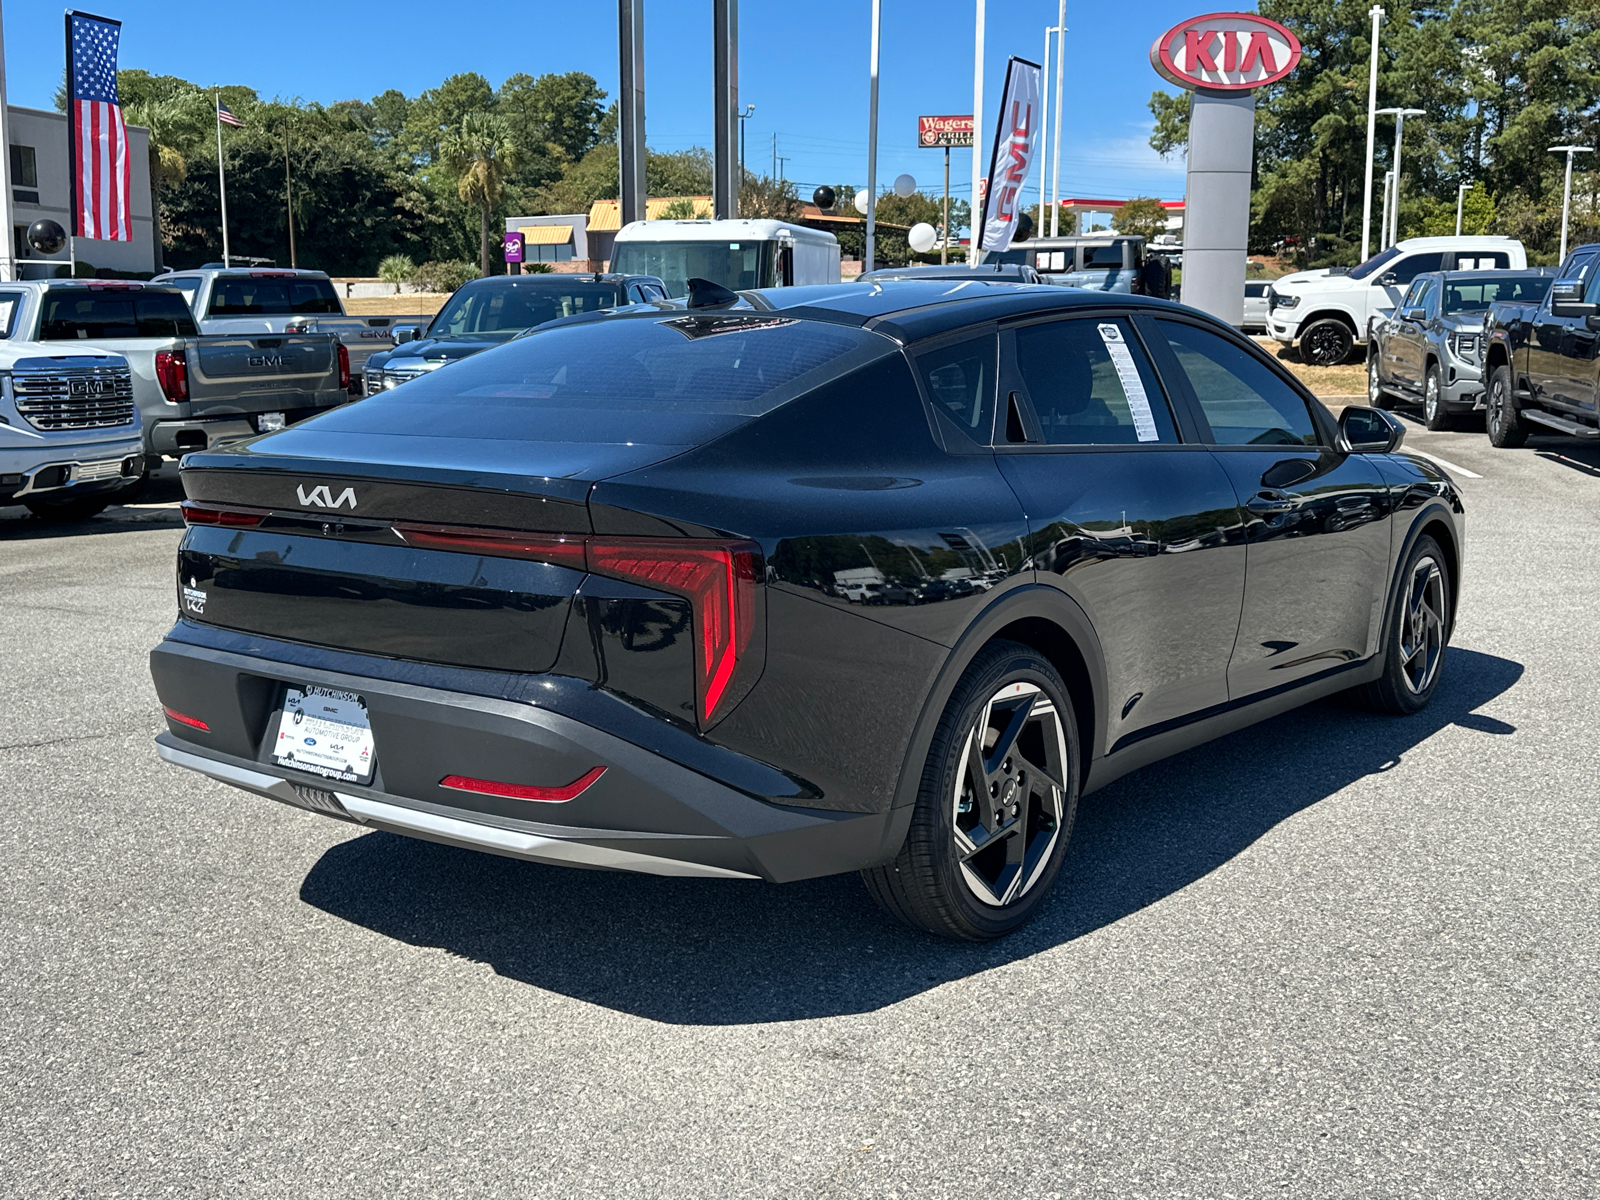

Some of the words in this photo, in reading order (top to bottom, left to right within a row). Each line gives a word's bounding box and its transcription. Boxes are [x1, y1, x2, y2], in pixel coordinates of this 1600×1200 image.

[1184, 30, 1278, 72] KIA
[921, 117, 974, 132] Wagers
[997, 100, 1031, 222] GMC
[360, 330, 392, 339] GM
[247, 355, 294, 367] GMC
[71, 381, 114, 394] GMC
[296, 484, 358, 510] KIA
[313, 686, 360, 703] HUTCHINSON
[323, 706, 338, 714] GMC
[304, 726, 340, 740] AUTOMOTIVE
[340, 732, 361, 743] GROUP
[277, 755, 358, 782] Hutchinsonautogroup.com
